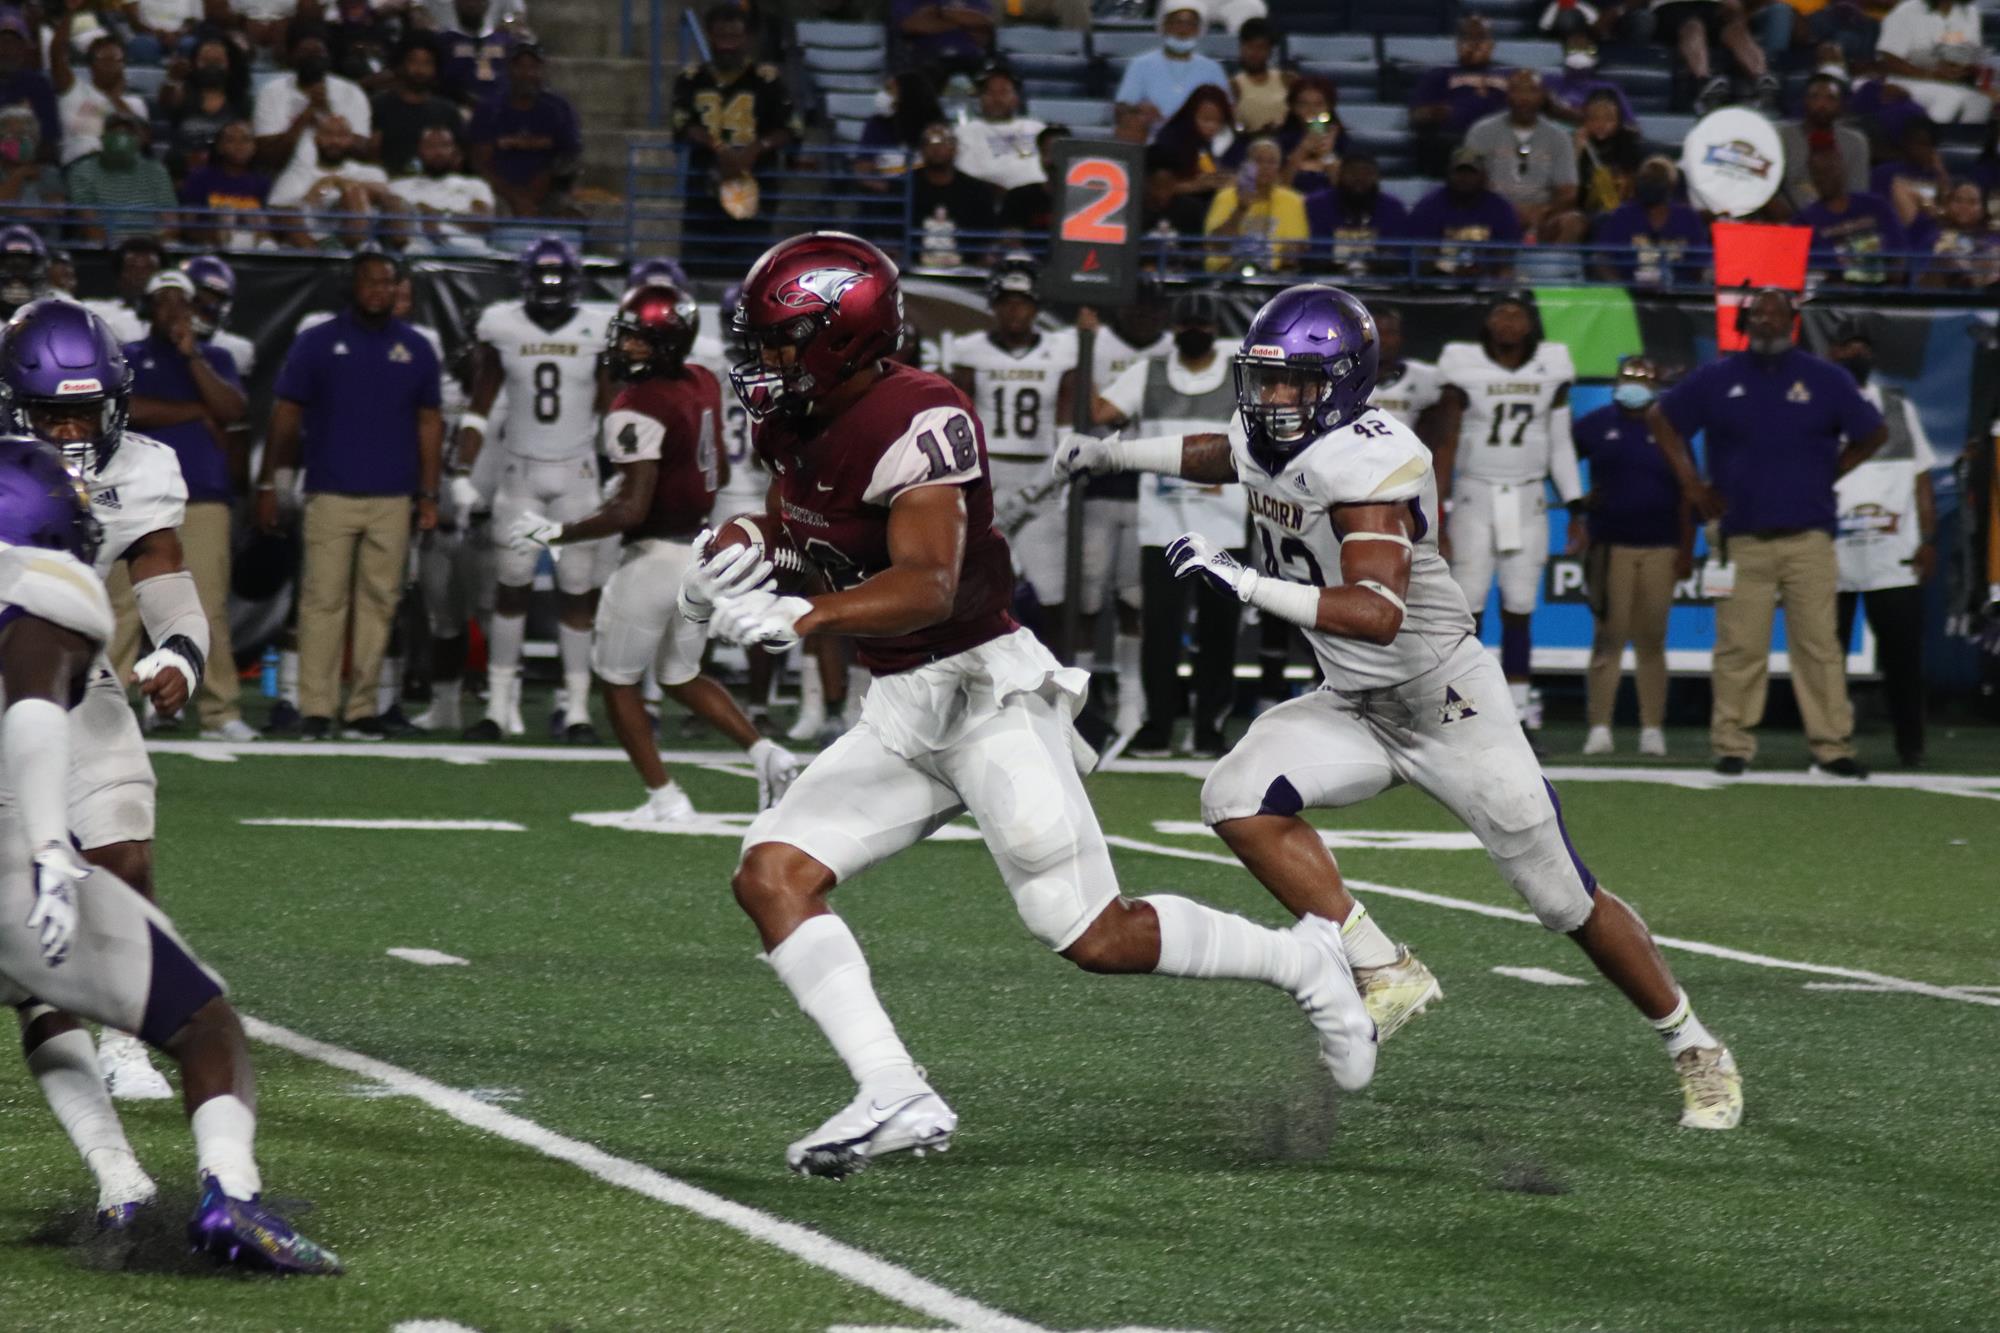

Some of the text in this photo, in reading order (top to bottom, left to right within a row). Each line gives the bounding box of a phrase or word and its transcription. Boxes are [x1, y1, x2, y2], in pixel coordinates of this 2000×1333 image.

[1061, 159, 1129, 244] 2
[1251, 348, 1279, 357] Riddell
[534, 362, 560, 424] 8
[993, 386, 1041, 439] 18
[617, 422, 639, 456] 4
[916, 413, 978, 480] 18
[1353, 419, 1393, 439] 42
[1487, 403, 1535, 447] 17
[1247, 485, 1305, 533] ALCORN
